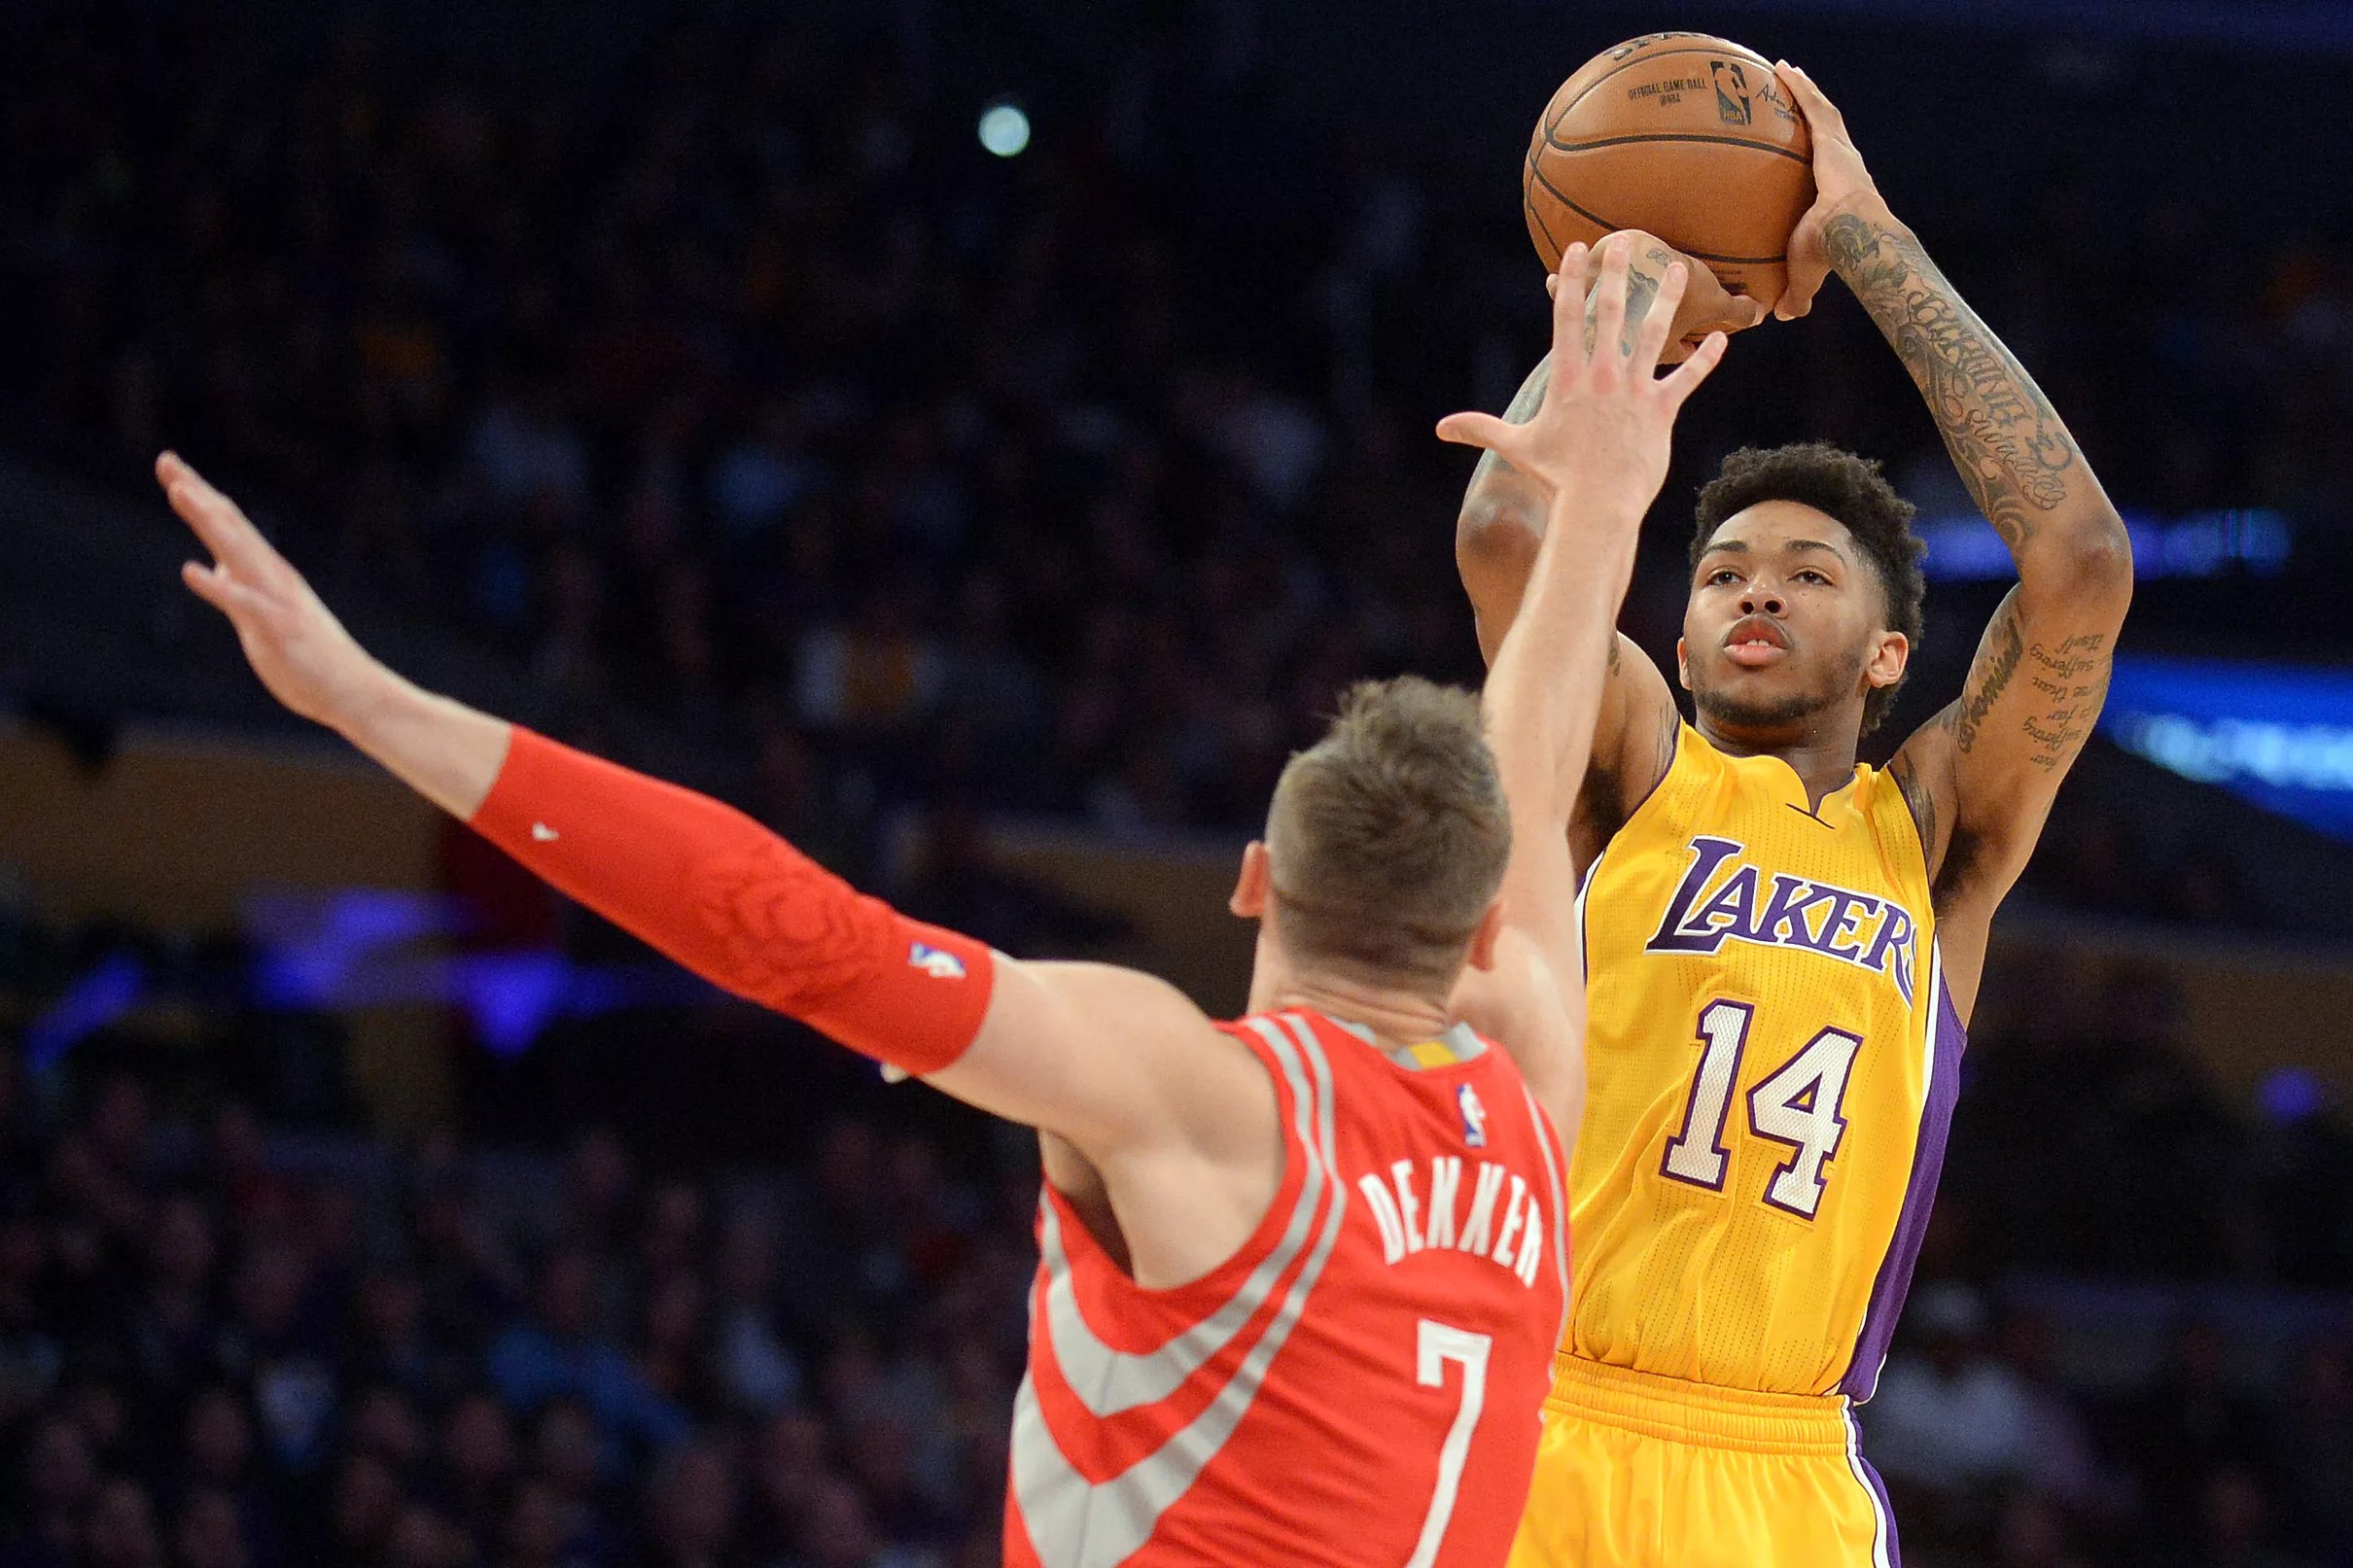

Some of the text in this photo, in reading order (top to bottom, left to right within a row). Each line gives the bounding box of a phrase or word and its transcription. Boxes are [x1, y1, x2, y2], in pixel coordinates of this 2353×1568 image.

[1629, 78, 1707, 100] OFFICIAL GAME BALL
[1660, 997, 1865, 1222] 14
[1358, 1156, 1543, 1289] DEKKER
[1404, 1317, 1493, 1568] 7
